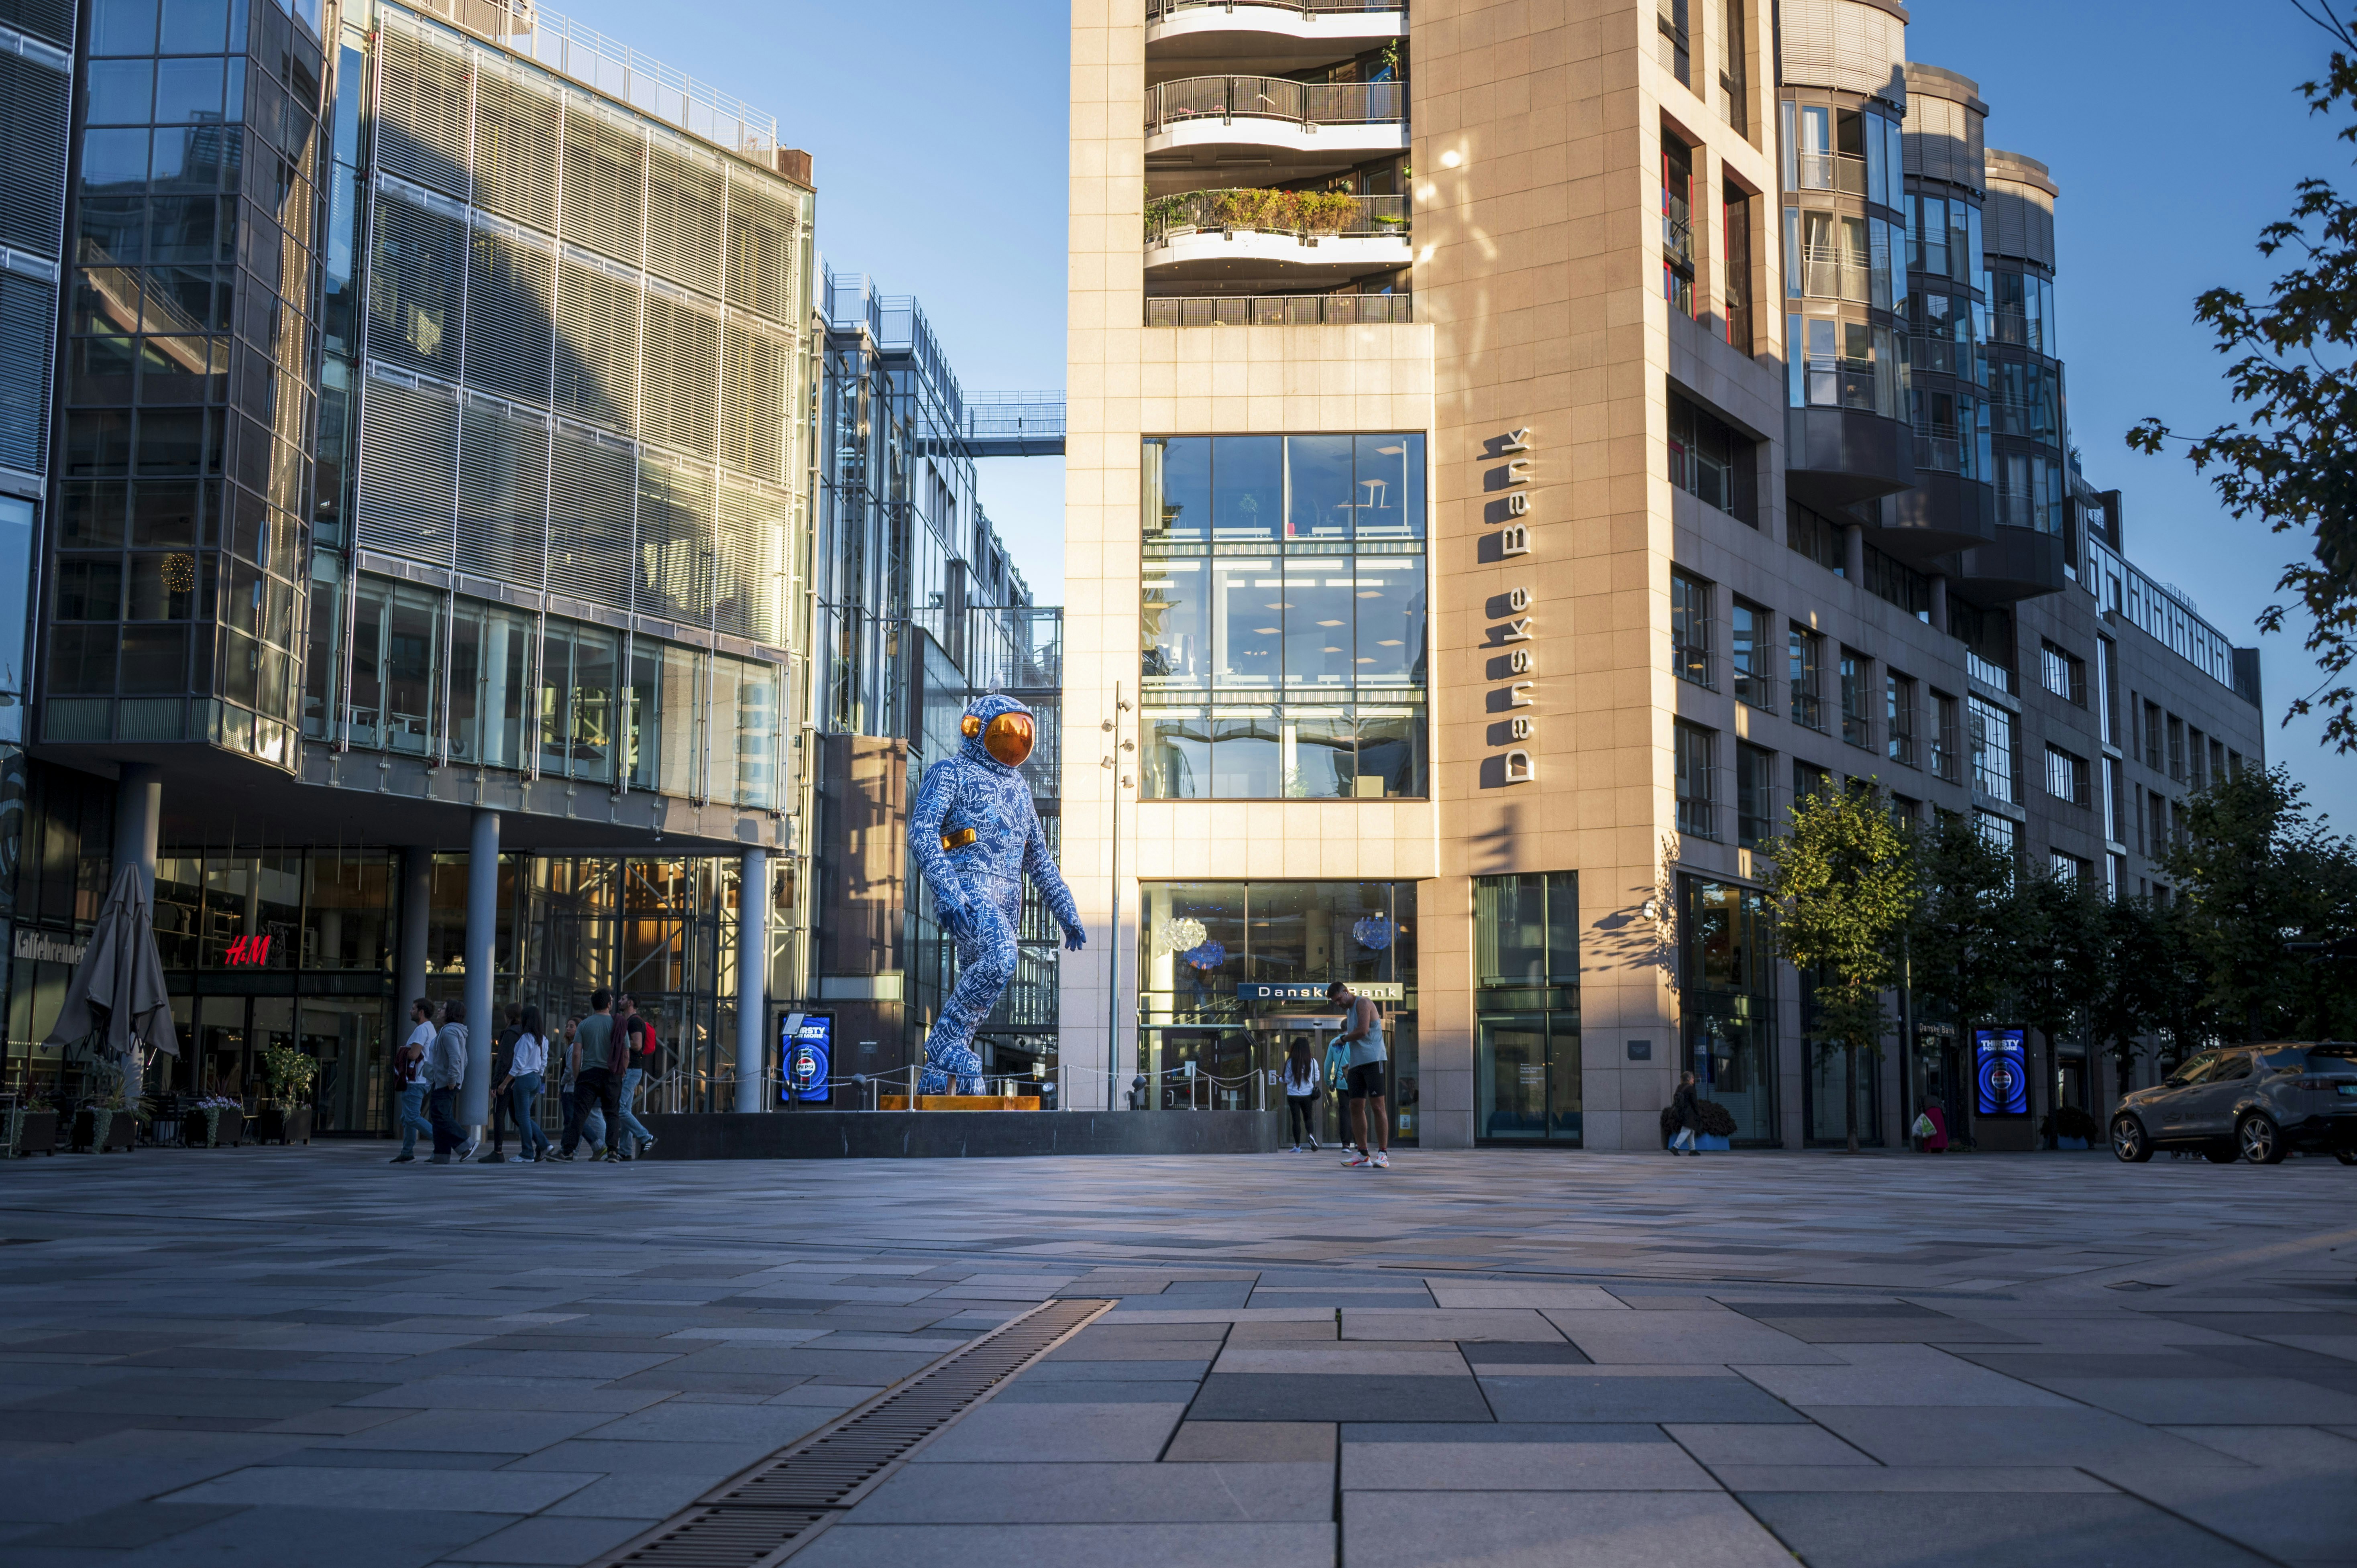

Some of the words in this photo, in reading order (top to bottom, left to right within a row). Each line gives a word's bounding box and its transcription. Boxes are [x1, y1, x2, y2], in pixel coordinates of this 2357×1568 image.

[1502, 426, 1530, 556] Bank
[1503, 586, 1534, 782] Danske
[225, 935, 271, 966] H&M
[1259, 987, 1328, 997] Dansk
[1919, 1022, 1939, 1033] Danske
[1941, 1025, 1955, 1034] Bank
